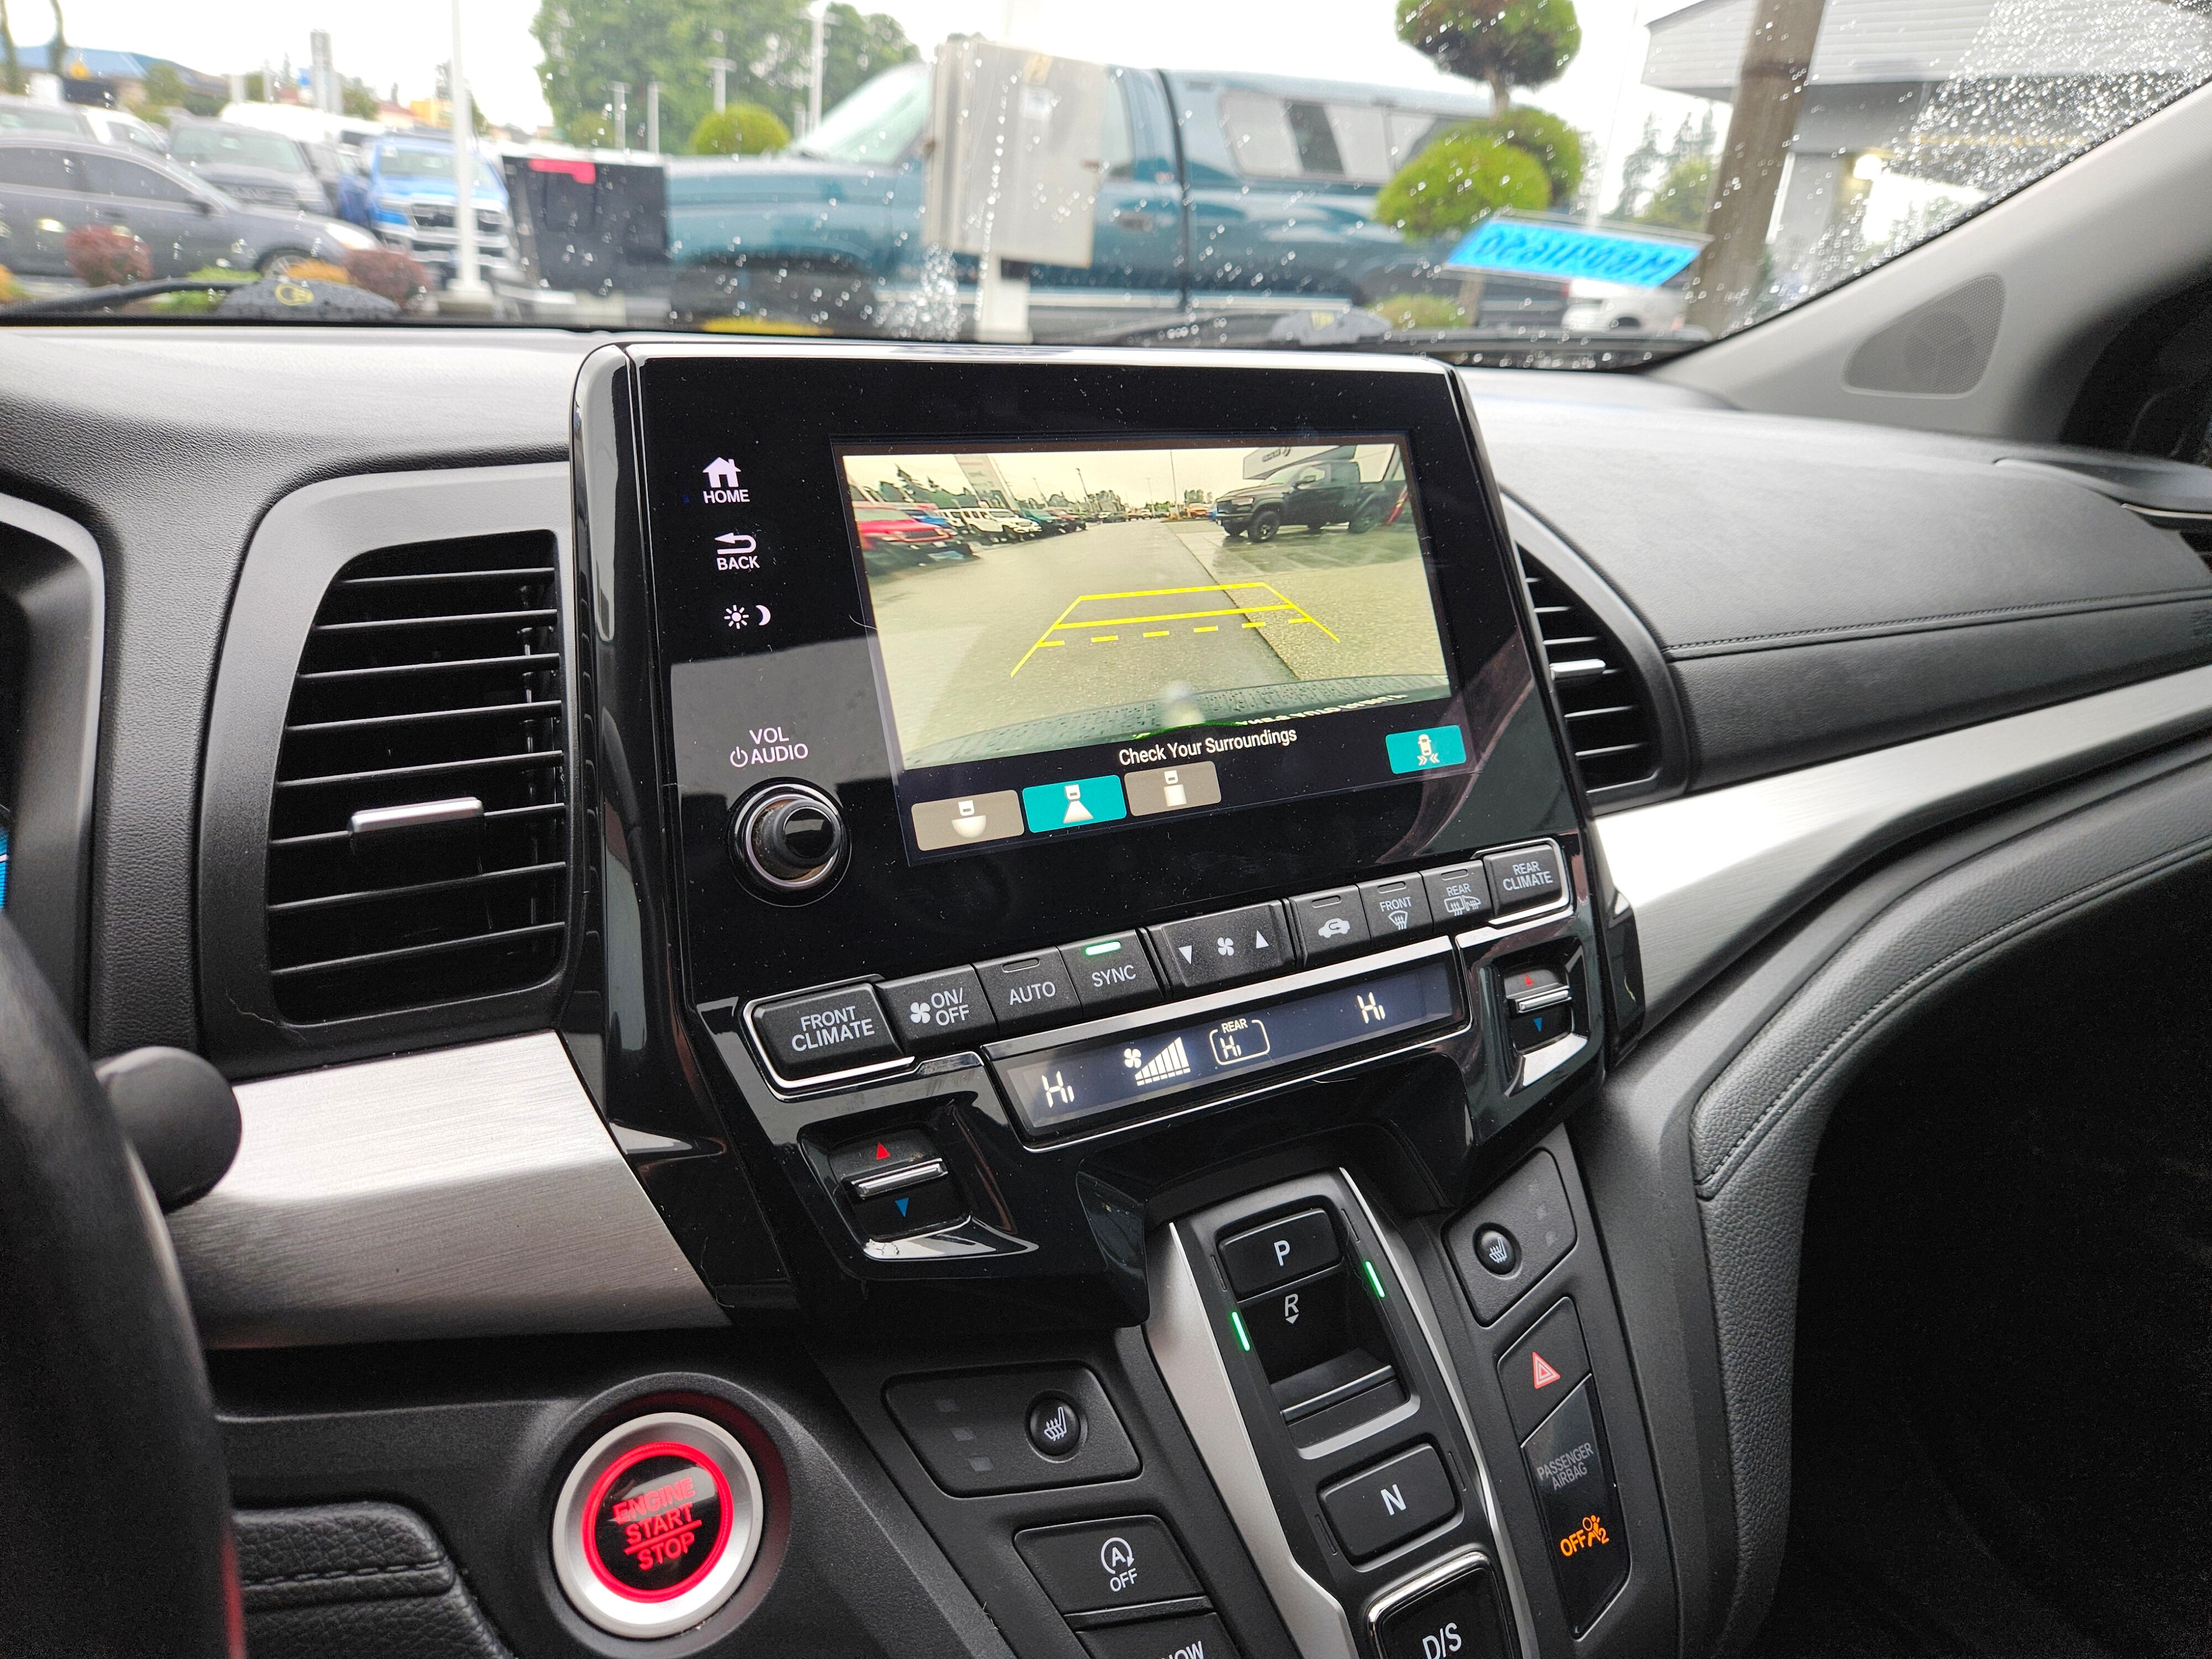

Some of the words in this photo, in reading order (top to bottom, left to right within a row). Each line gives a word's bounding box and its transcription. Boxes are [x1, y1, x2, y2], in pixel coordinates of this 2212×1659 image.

[703, 489, 750, 504] HOME
[716, 555, 760, 571] BACK
[749, 727, 789, 744] VOL
[1119, 745, 1167, 765] Check
[1167, 742, 1202, 758] Your
[1204, 728, 1297, 753] Surroundings
[751, 743, 808, 765] AUDIO
[1512, 861, 1541, 875] REAR
[1446, 883, 1472, 896] REAR
[1503, 870, 1553, 891] CLIMATE
[1379, 896, 1411, 912] FRONT
[1092, 964, 1136, 987] SYNC
[931, 987, 964, 1007] ON/
[1010, 981, 1056, 1005] AUTO
[800, 1005, 858, 1032] FRONT
[935, 1004, 970, 1026] OFF
[1221, 1018, 1248, 1034] REAR
[791, 1018, 875, 1052] CLIMATE
[1274, 1240, 1290, 1266] P
[1285, 1293, 1299, 1317] R
[1536, 1442, 1594, 1481] PASSENGER
[1552, 1462, 1588, 1491] AIRBAG
[612, 1477, 696, 1525] ENGINE
[1380, 1484, 1406, 1516] N
[624, 1501, 693, 1545] START
[637, 1531, 695, 1571] STOP
[1560, 1529, 1586, 1557] OFF
[1109, 1567, 1138, 1592] OFF
[1162, 1640, 1204, 1659] OW
[1422, 1623, 1462, 1659] D/S
